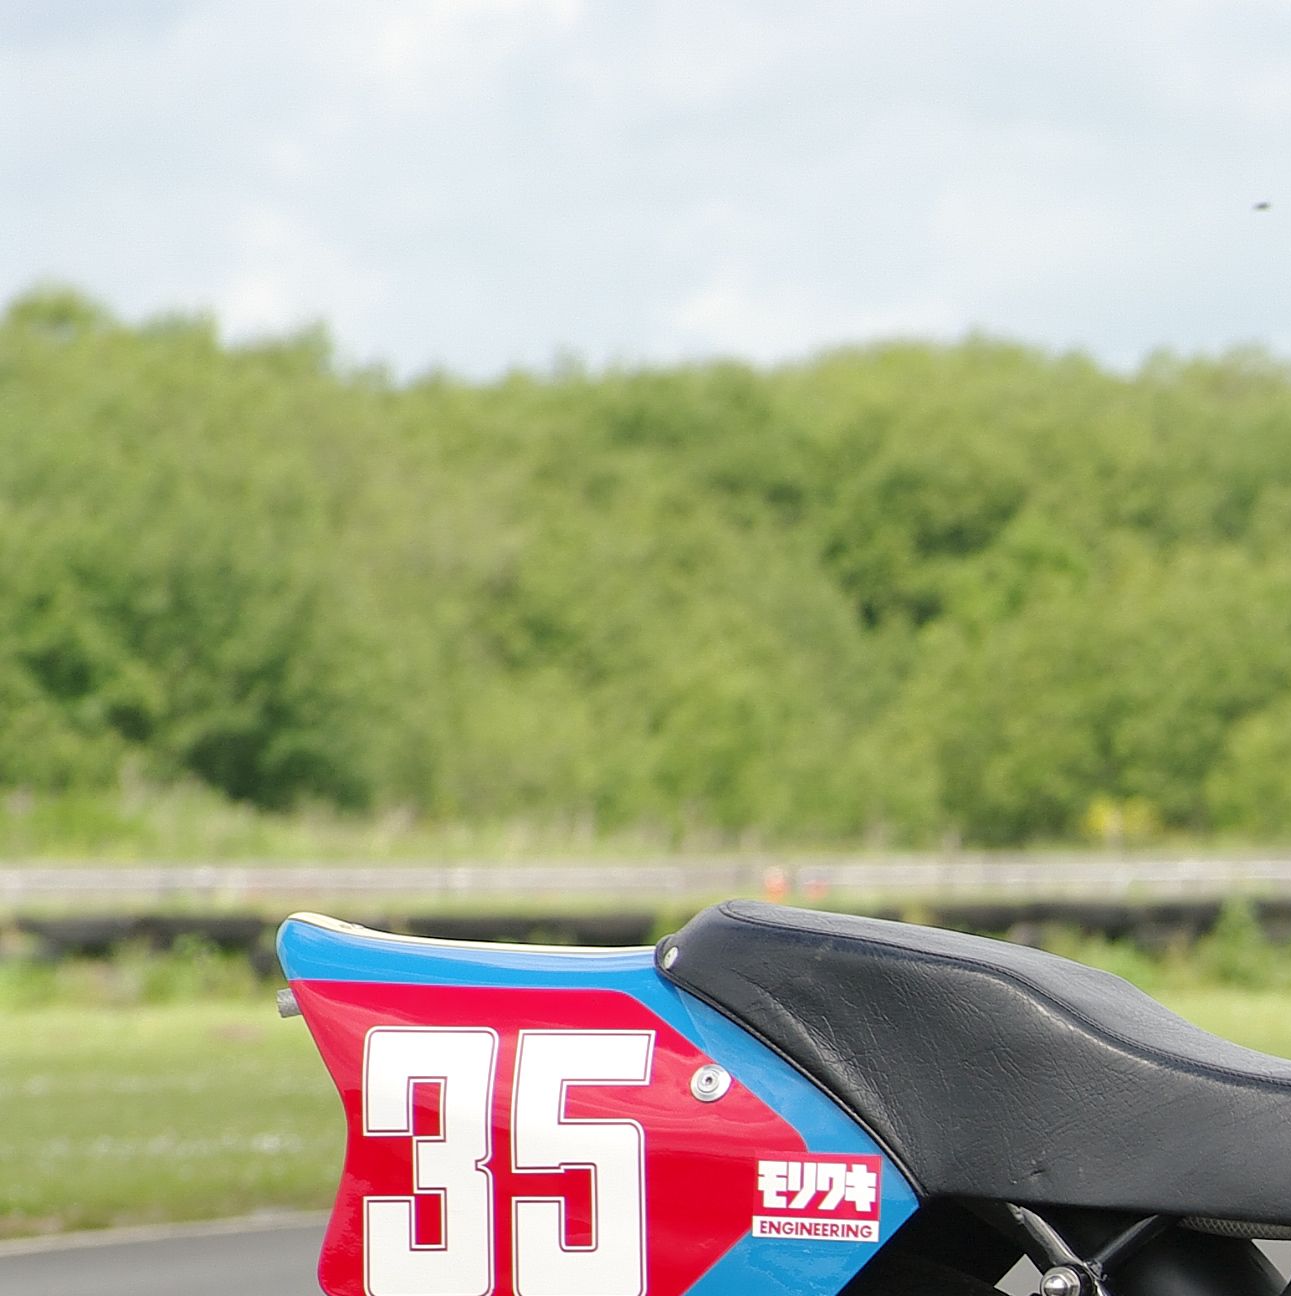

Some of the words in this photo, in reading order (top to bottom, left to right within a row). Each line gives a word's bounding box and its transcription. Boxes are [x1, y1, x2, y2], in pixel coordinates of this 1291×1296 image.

[757, 1160, 877, 1212] モリワキ
[760, 1220, 873, 1239] ENGINEERING
